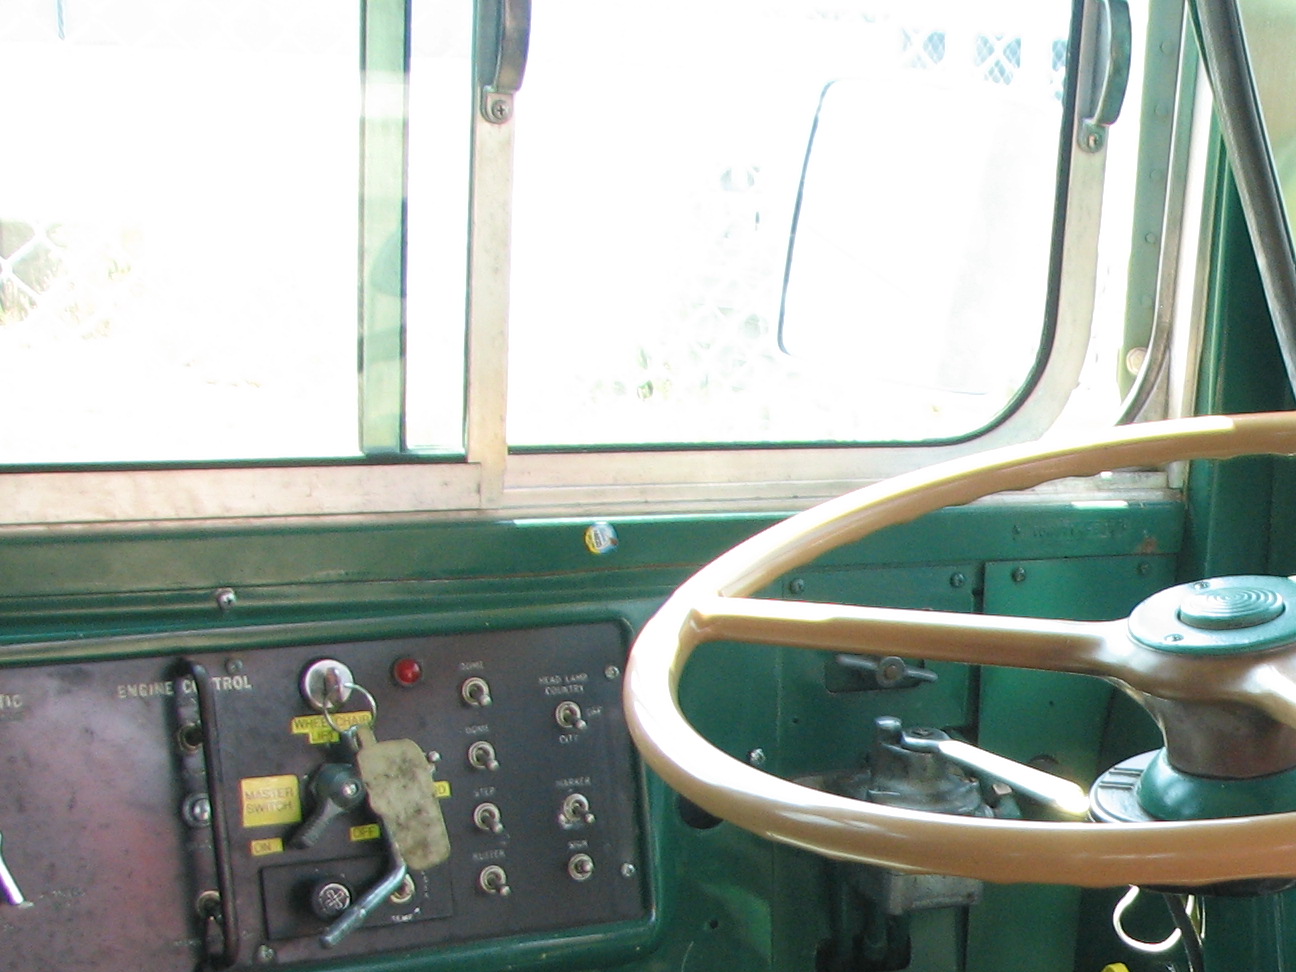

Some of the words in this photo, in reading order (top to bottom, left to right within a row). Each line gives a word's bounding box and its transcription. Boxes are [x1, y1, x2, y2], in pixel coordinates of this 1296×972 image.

[117, 681, 175, 698] ENGINE
[182, 675, 252, 695] COTROL
[245, 787, 293, 800] MASTER
[246, 801, 293, 815] SWITCH
[354, 826, 377, 838] OFF
[254, 842, 272, 854] ON
